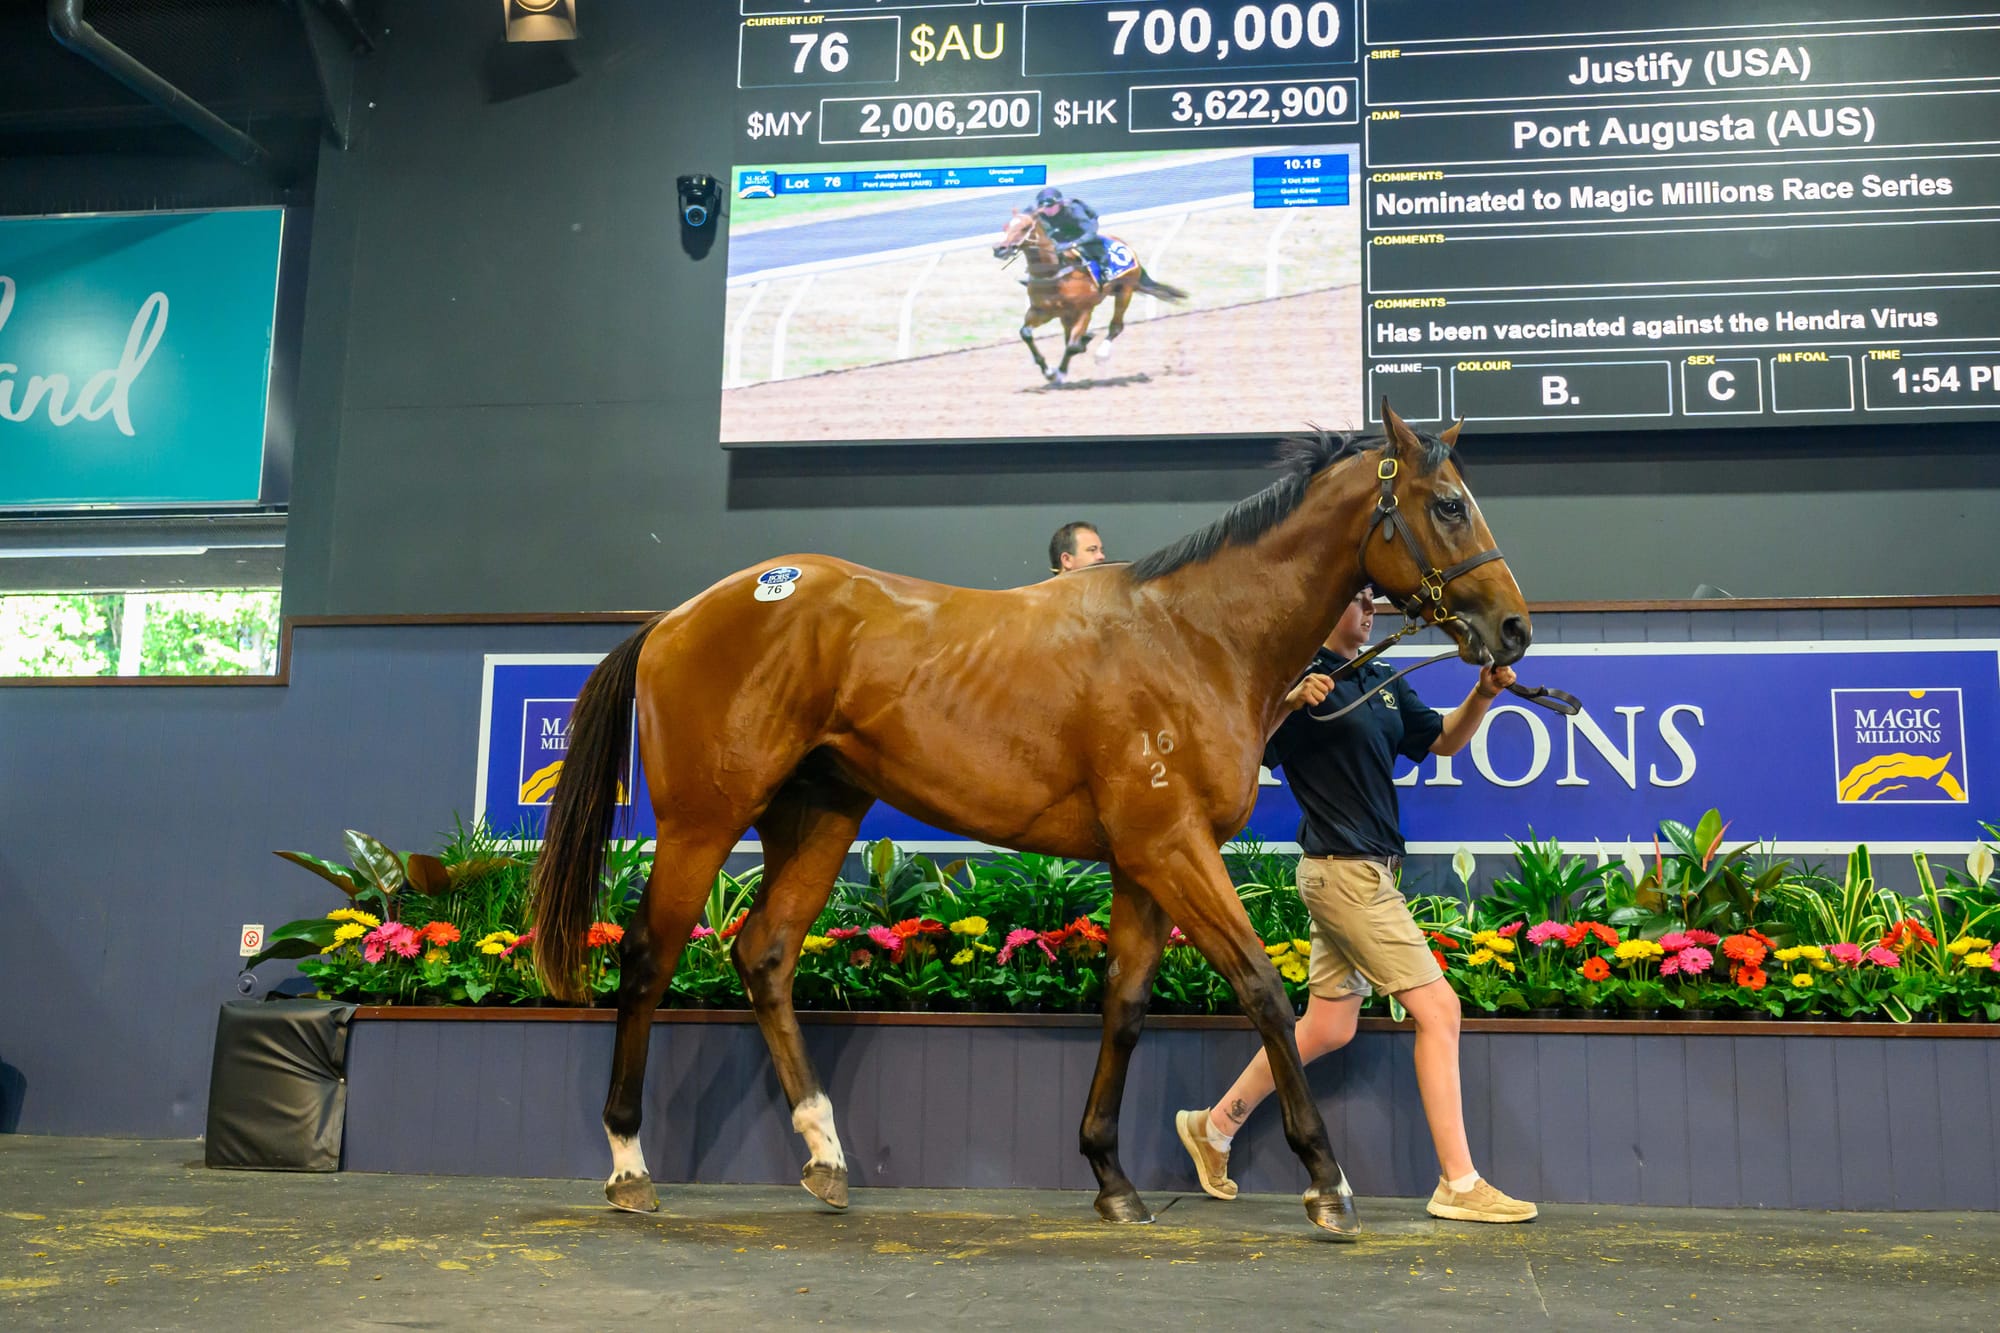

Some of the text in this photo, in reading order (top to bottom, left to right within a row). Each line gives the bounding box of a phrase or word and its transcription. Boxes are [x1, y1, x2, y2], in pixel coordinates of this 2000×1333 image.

[746, 15, 825, 27] CURRENT LOT
[1107, 2, 1340, 60] 700,000
[790, 32, 849, 73] 76
[910, 22, 1004, 64] $AU
[1371, 50, 1401, 59] SIRE
[1568, 46, 1811, 88] Justify (USA)
[860, 97, 1031, 136] 2,006,200
[1053, 99, 1118, 128] $HK
[1171, 84, 1348, 125] 3,622,900
[1371, 110, 1400, 120] DAM
[747, 111, 812, 138] $MY
[1513, 107, 1876, 151] Port Augusta (AUS)
[785, 176, 841, 189] Lot 76
[1373, 171, 1444, 182] COMMENTS
[1376, 174, 1953, 216] Nominated to Magic Millions Race Series
[1374, 234, 1445, 245] COMMENTS
[1374, 298, 1446, 309] COMMENTS
[1377, 307, 1939, 343] Has been vaccinated against the Hendra Virus
[1375, 363, 1423, 373] ONLINE
[1457, 361, 1512, 371] COLOUR
[1687, 355, 1715, 365] SEX
[1778, 352, 1830, 363] IN FOAL
[1869, 350, 1900, 360] TIME
[1542, 376, 1580, 405] B.
[1707, 370, 1736, 400] C
[1892, 365, 2000, 394] 1:54 P
[767, 585, 782, 595] 76
[1853, 708, 1941, 729] MAGIC
[1142, 730, 1174, 756] 16
[1856, 730, 1941, 744] MILLIONS
[1150, 761, 1169, 788] 2
